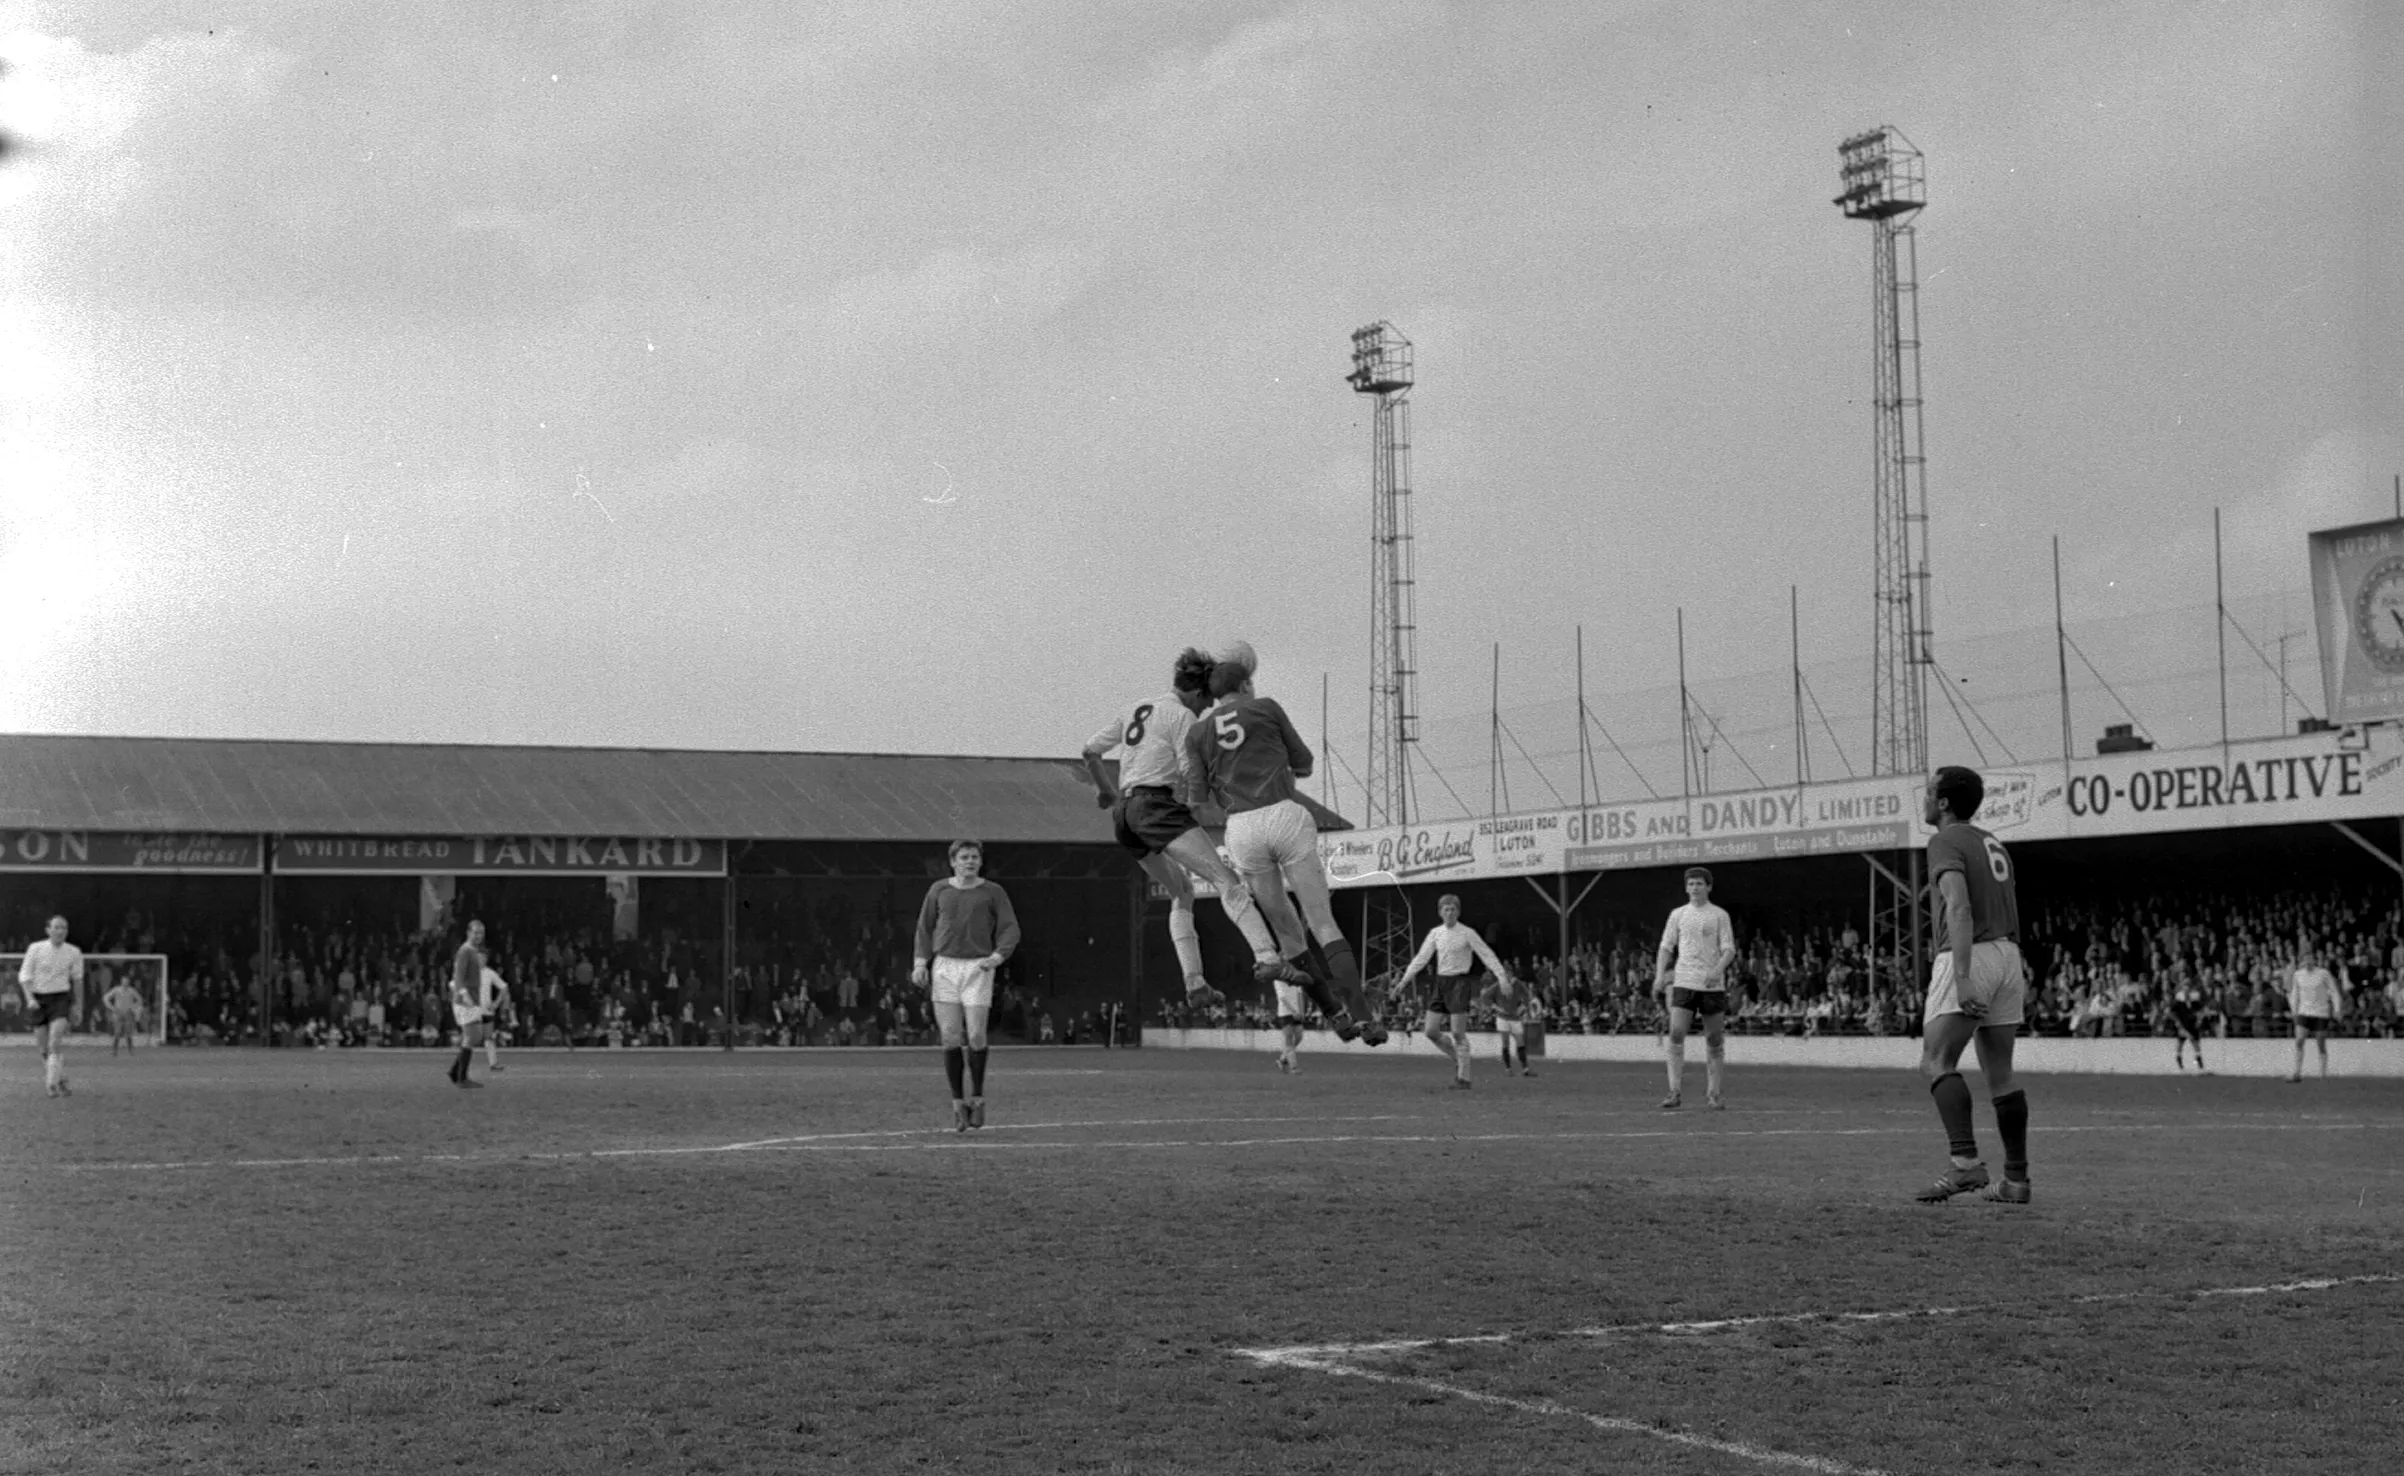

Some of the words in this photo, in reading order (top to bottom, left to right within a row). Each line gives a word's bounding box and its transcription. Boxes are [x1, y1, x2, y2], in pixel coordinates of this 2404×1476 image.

[1125, 704, 1154, 746] 8
[1214, 710, 1245, 750] 5
[2068, 753, 2363, 816] CO-OPERATIVE
[1566, 810, 1638, 841] GIBBS
[1646, 814, 1690, 836] AND
[1818, 794, 1901, 822] LIMITED
[0, 831, 89, 861] ON
[294, 838, 450, 858] WHITBREAD
[469, 835, 702, 867] TANKARD
[1500, 835, 1536, 851] LUTON
[1983, 836, 2009, 882] 6
